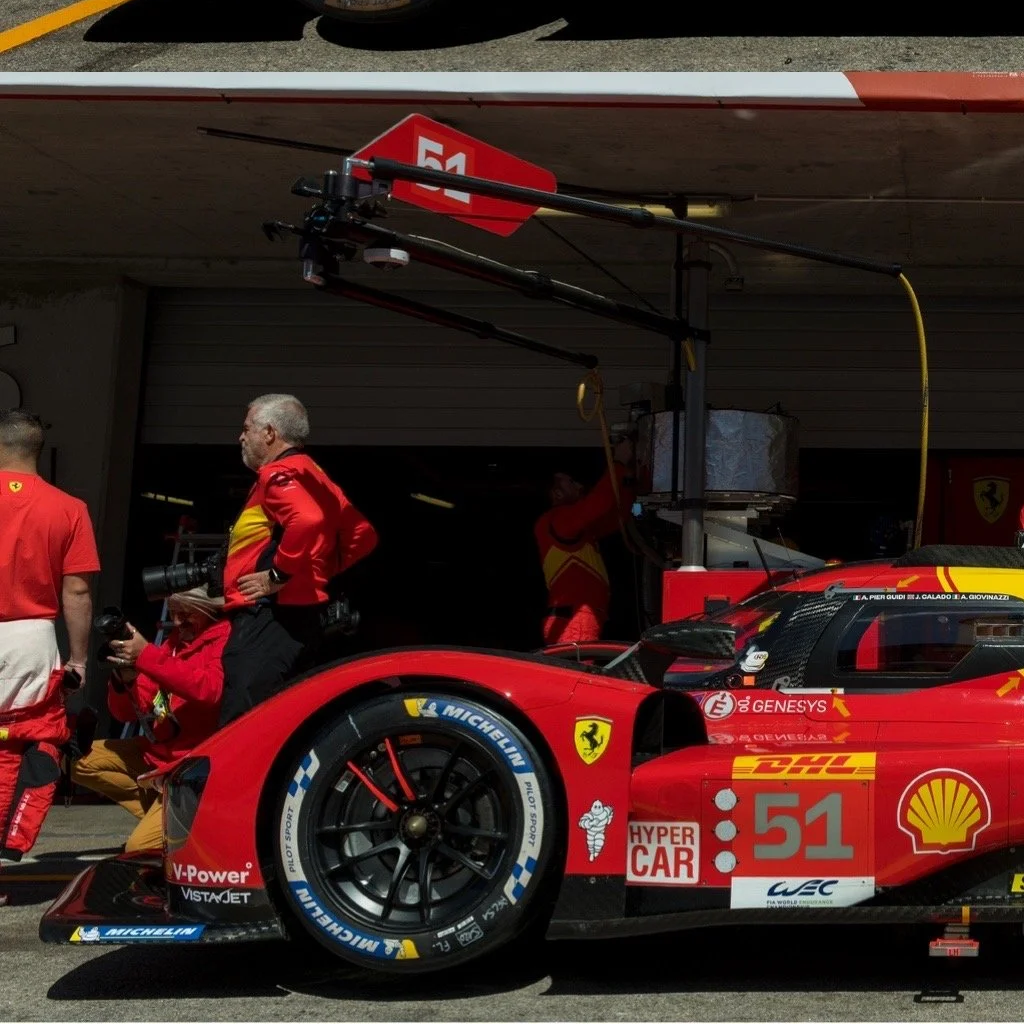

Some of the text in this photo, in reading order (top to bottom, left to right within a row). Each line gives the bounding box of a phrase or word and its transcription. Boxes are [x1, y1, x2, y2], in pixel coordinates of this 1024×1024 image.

[415, 135, 470, 204] 51
[753, 699, 827, 713] GENESYS
[442, 704, 525, 768] MICHELIN
[751, 756, 858, 774] DHL
[524, 780, 538, 848] PILOT SPORT
[754, 792, 854, 860] 51
[284, 806, 297, 873] PILOT SPORT
[630, 825, 695, 846] HYPER
[173, 862, 252, 884] V-Power
[631, 846, 694, 878] CAR
[767, 879, 839, 897] WEC
[105, 927, 197, 936] MICHELIN
[296, 887, 380, 954] MICHELIN
